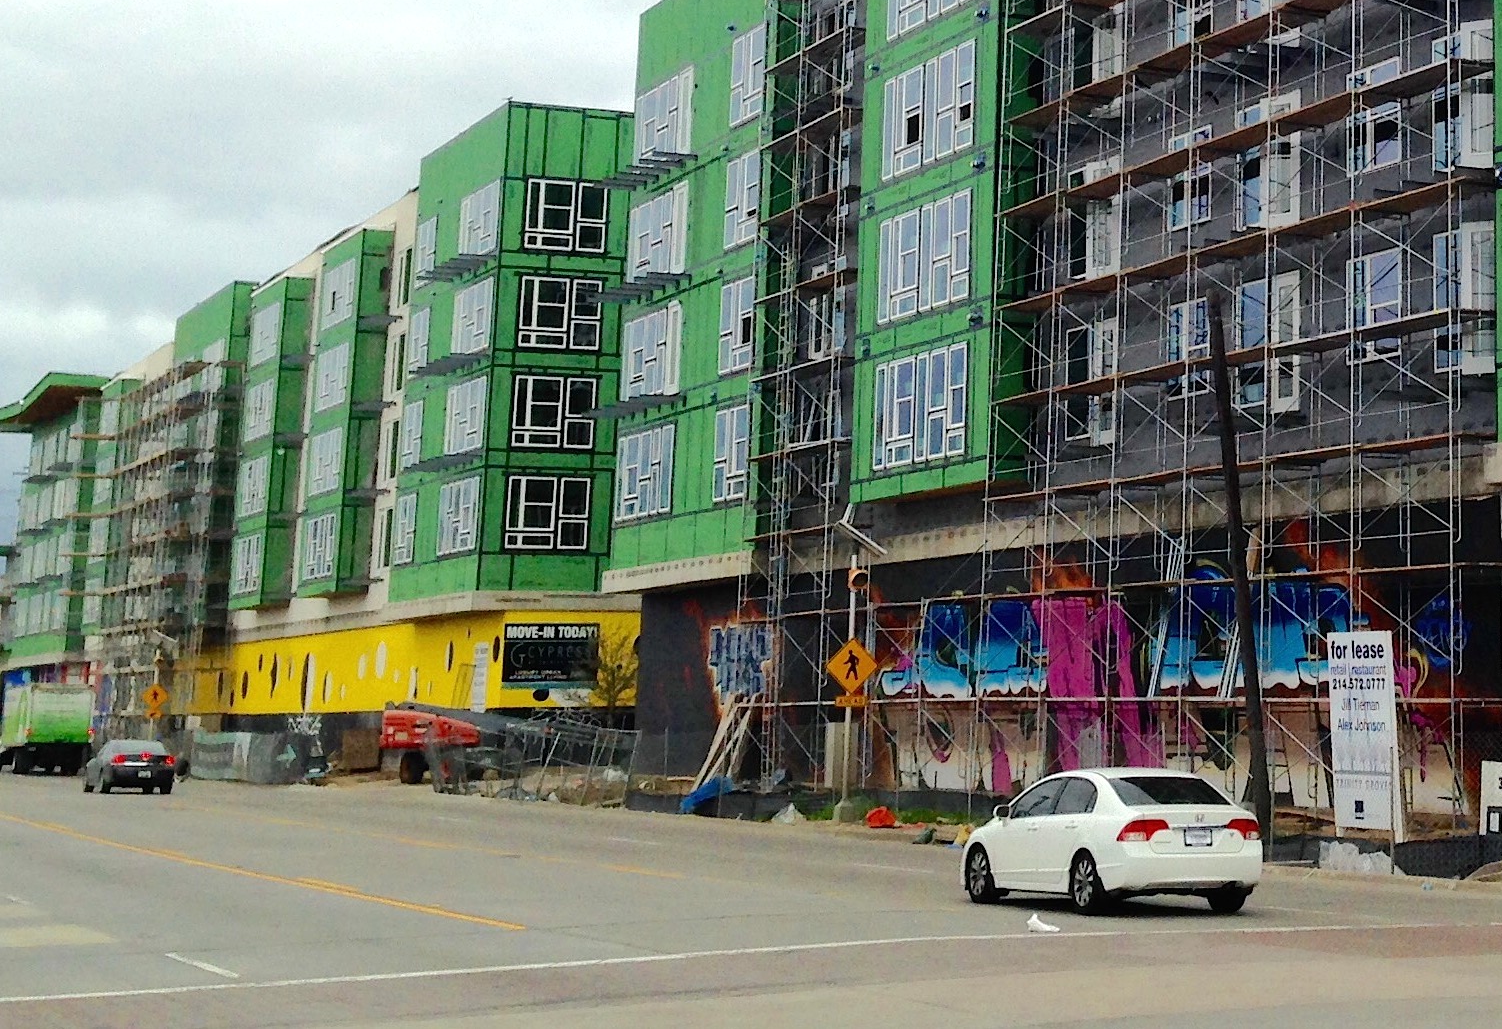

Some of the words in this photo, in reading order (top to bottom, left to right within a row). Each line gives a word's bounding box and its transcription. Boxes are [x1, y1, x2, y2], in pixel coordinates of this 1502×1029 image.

[506, 626, 555, 639] MOVE-IN
[558, 626, 598, 639] TODAY!
[1330, 640, 1348, 660] for
[1351, 640, 1385, 660] lease
[1332, 677, 1386, 690] 214.572.0777
[1337, 717, 1353, 731] Alex
[1354, 718, 1386, 732] Johnson
